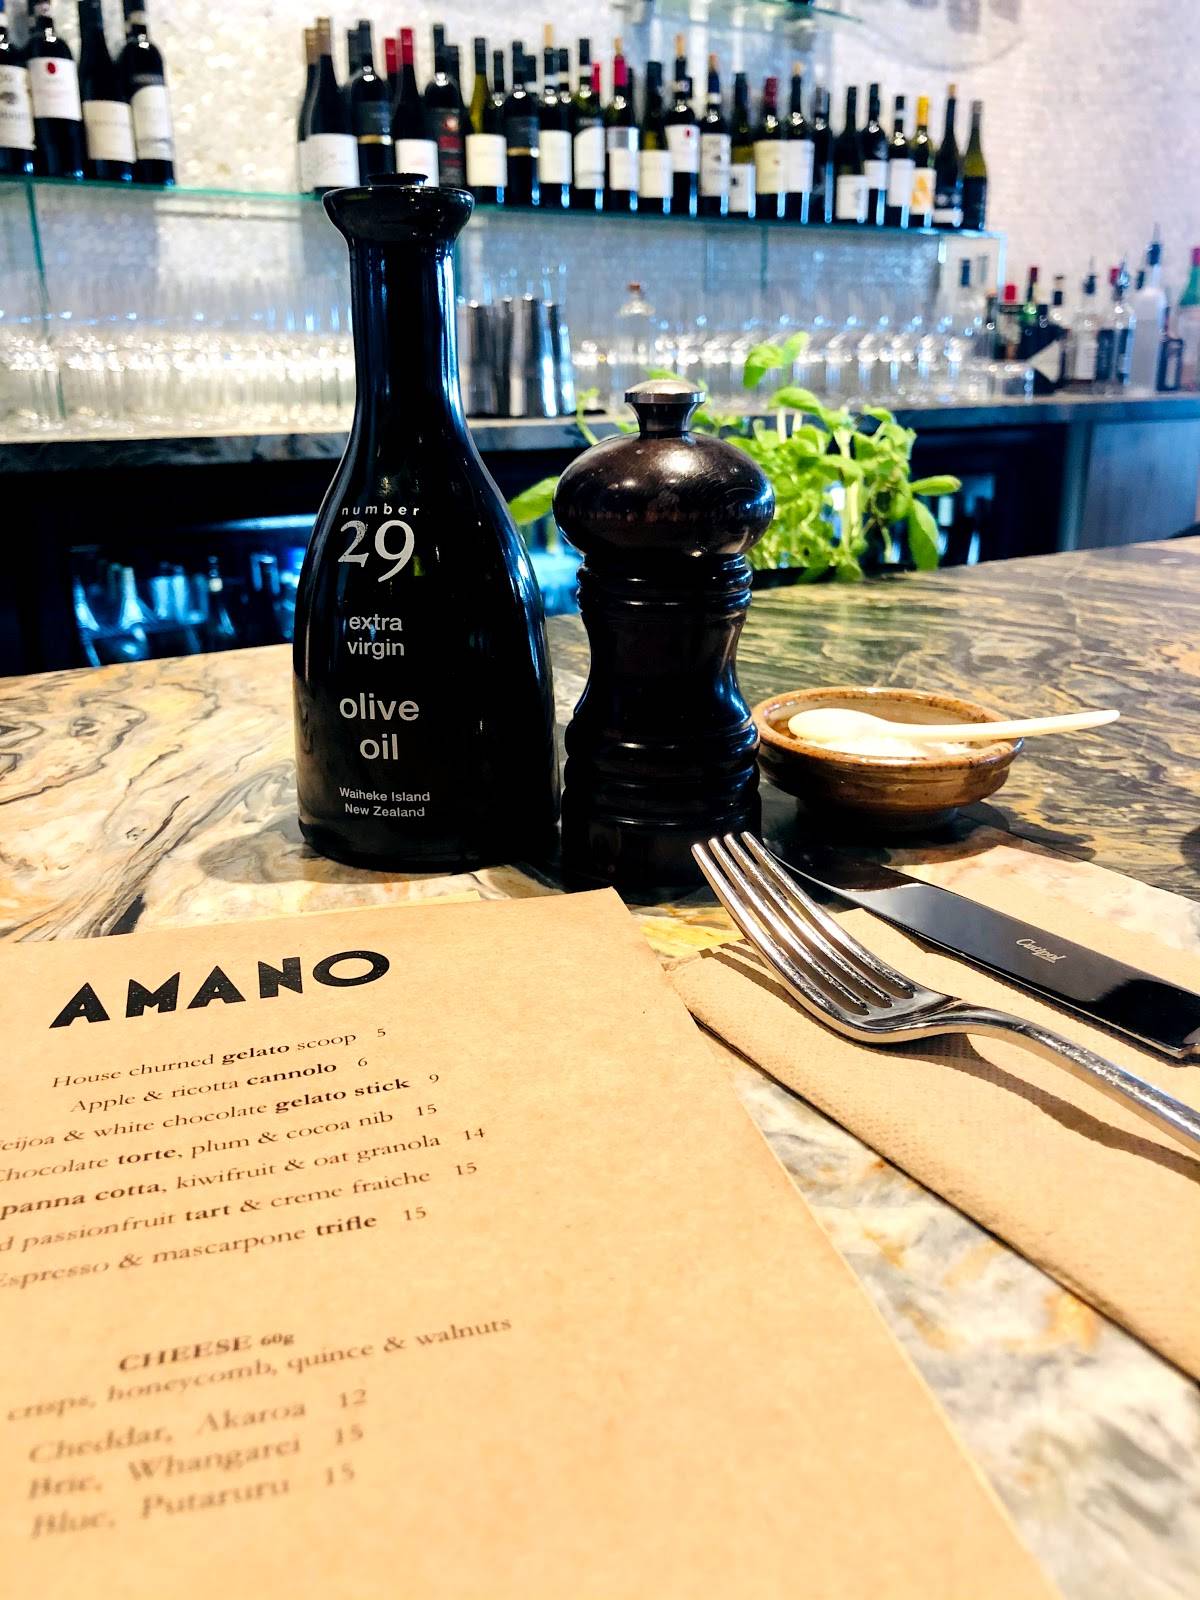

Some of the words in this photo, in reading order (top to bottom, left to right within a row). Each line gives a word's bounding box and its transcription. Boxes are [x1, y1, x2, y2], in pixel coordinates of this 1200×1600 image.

[342, 503, 420, 515] number
[338, 520, 415, 582] 29
[347, 638, 405, 660] virgin
[349, 614, 403, 631] extra
[339, 693, 420, 721] olive
[360, 733, 398, 760] oil
[339, 787, 388, 801] Waiheke
[391, 792, 431, 802] Island
[345, 803, 369, 815] New
[373, 806, 425, 817] Zealand
[49, 951, 390, 1028] AMANO
[52, 1072, 122, 1088] House
[129, 1054, 214, 1077] churned
[222, 1044, 290, 1065] gelato
[298, 1032, 356, 1051] scoop
[377, 1028, 386, 1038] 5
[70, 1093, 136, 1113] Apple
[143, 1090, 163, 1101] &
[172, 1080, 238, 1098] ricotta
[247, 1063, 337, 1086] cannolo
[357, 1057, 368, 1067] 6
[0, 1134, 55, 1152] eijoa
[64, 1130, 85, 1142] &
[94, 1119, 154, 1138] white
[163, 1103, 267, 1128] chocolate
[275, 1088, 346, 1113] gelato
[354, 1078, 410, 1097] stick
[429, 1074, 439, 1084] 9
[118, 1148, 182, 1165] torte,
[191, 1137, 249, 1158] plum
[258, 1132, 279, 1144] &
[286, 1121, 350, 1139] cocoa
[359, 1111, 393, 1126] nib
[417, 1104, 437, 1116] 15
[0, 1193, 85, 1220] panna
[95, 1184, 167, 1202] cotta,
[177, 1164, 276, 1190] kiwifruit
[284, 1160, 306, 1172] &
[314, 1152, 348, 1167] oat
[357, 1136, 440, 1163] granola
[463, 1128, 486, 1141] 14
[22, 1213, 177, 1252] passionfruit
[186, 1205, 230, 1221] tart
[240, 1200, 262, 1212] &
[271, 1188, 343, 1208] creme
[353, 1171, 431, 1194] fraiche
[455, 1163, 477, 1176] 15
[119, 1255, 143, 1268] &
[153, 1229, 305, 1265] mascarpone
[316, 1215, 377, 1237] trifle
[405, 1207, 427, 1221] 15
[7, 1393, 97, 1421] crisps,
[106, 1359, 277, 1402] honeycomb,
[288, 1342, 374, 1374] quince
[383, 1337, 407, 1353] &
[416, 1318, 512, 1347] walnuts
[119, 1336, 252, 1372] CHEESE
[259, 1333, 294, 1348] 60g
[28, 1427, 173, 1464] Cheddar,
[196, 1401, 306, 1435] Akaroa
[339, 1389, 367, 1409] 12
[128, 1437, 301, 1482] Whangarei
[334, 1424, 364, 1446] 15
[140, 1479, 290, 1519] Putaruru
[324, 1465, 356, 1487] 15
